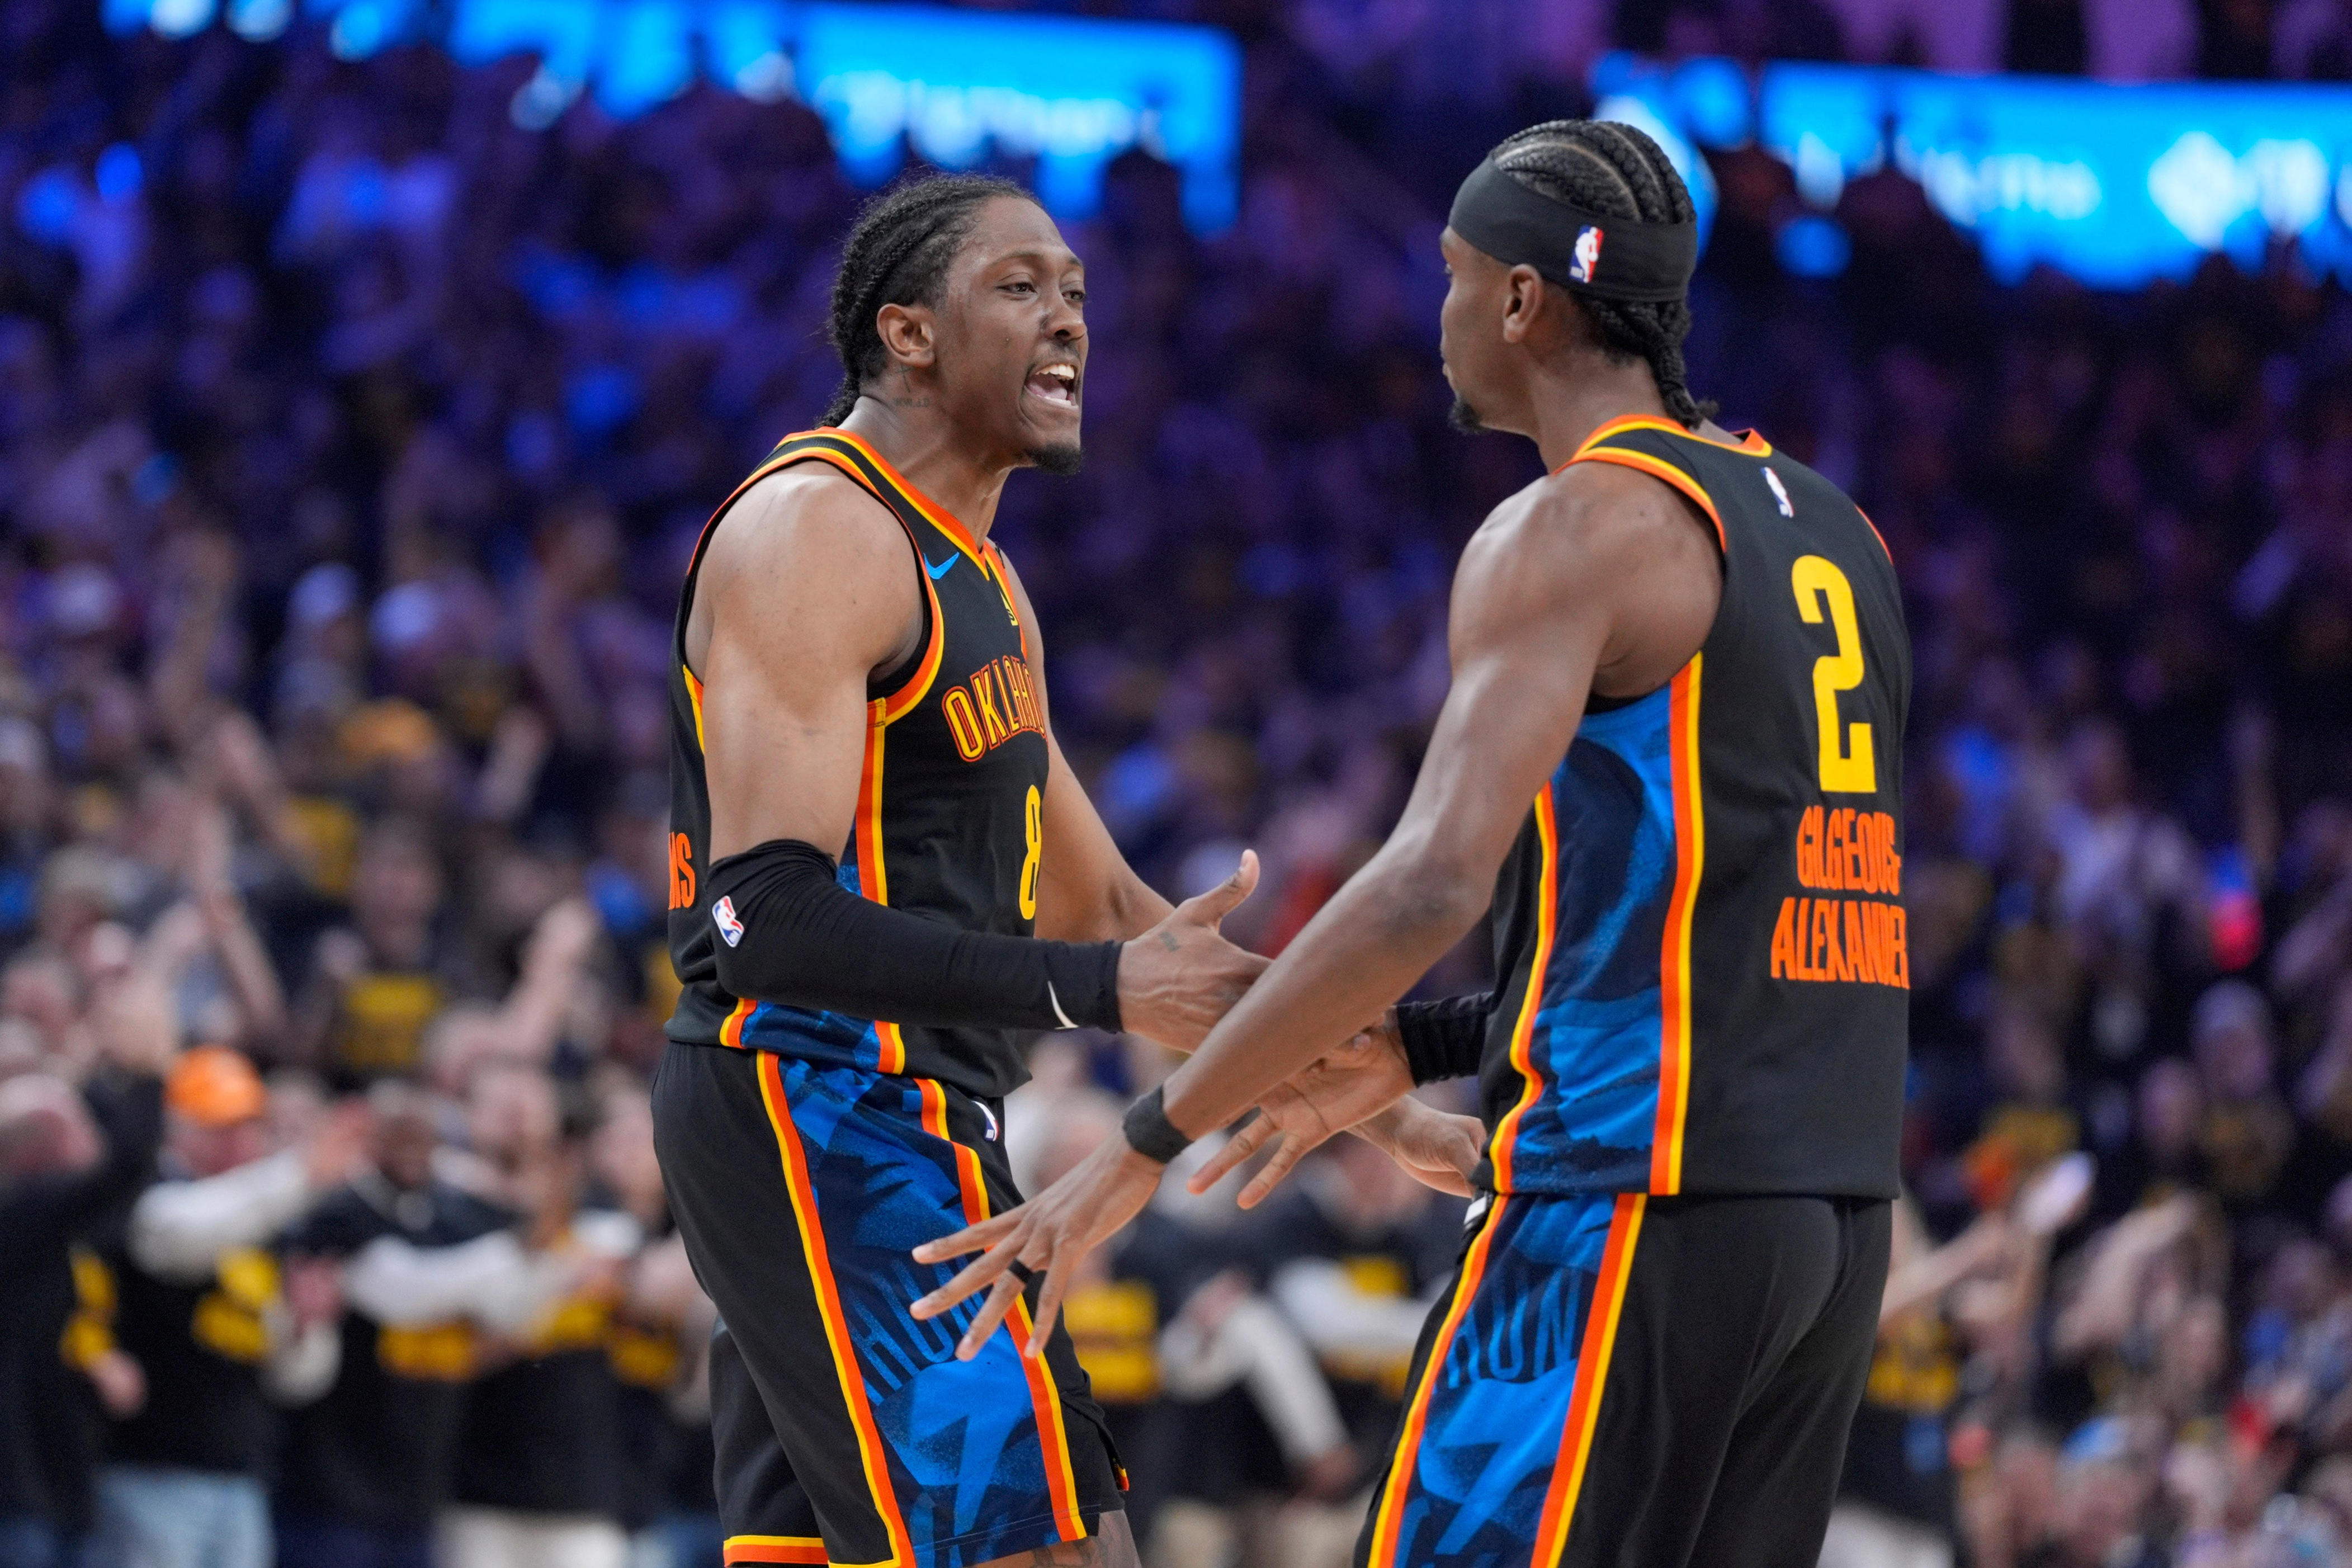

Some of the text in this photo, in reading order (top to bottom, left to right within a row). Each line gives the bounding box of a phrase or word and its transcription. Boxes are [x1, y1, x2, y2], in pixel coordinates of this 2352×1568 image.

[1792, 555, 1877, 793] 2
[1019, 784, 1042, 920] 8
[1770, 897, 1910, 989] ALEXANDER
